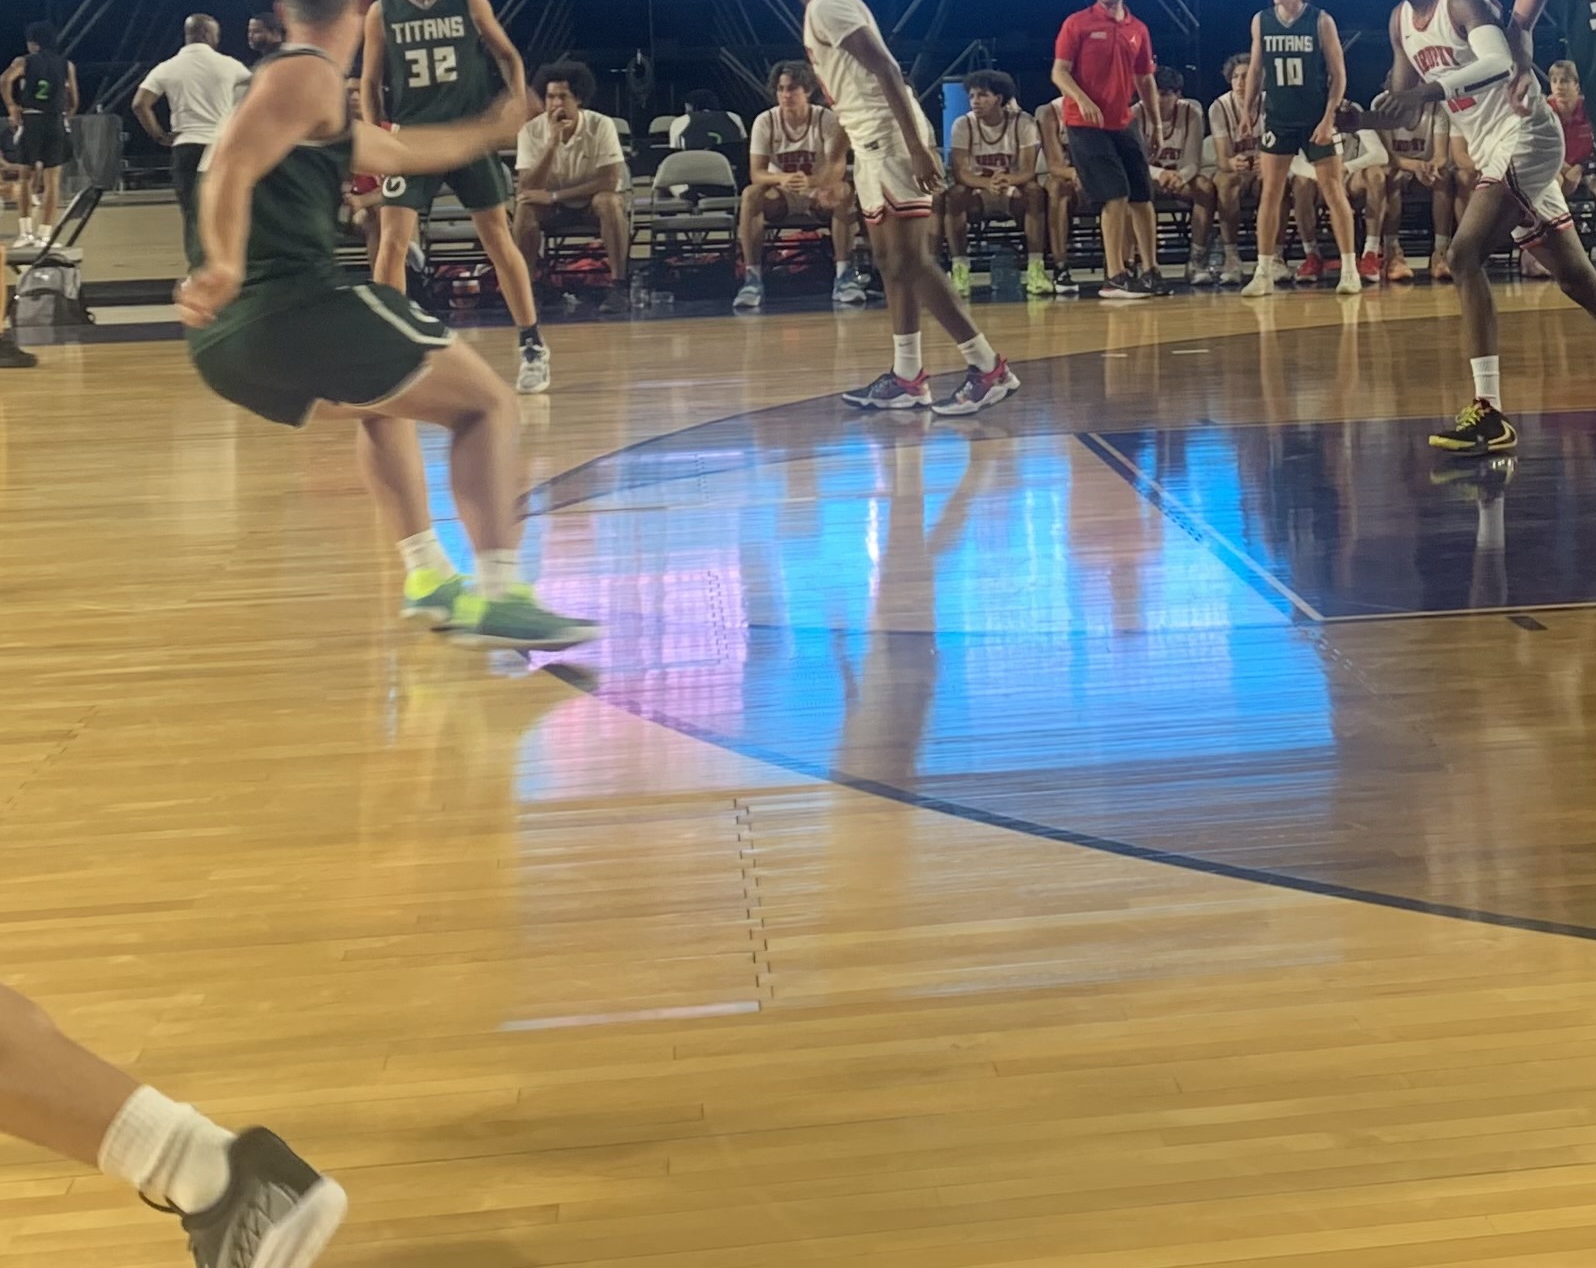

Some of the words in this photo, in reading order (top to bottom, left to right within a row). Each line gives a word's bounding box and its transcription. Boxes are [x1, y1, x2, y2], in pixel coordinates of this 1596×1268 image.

[391, 16, 465, 44] TITANS
[1263, 35, 1314, 53] TITANS
[405, 46, 458, 88] 32
[1274, 57, 1304, 86] 10
[35, 79, 49, 101] 2
